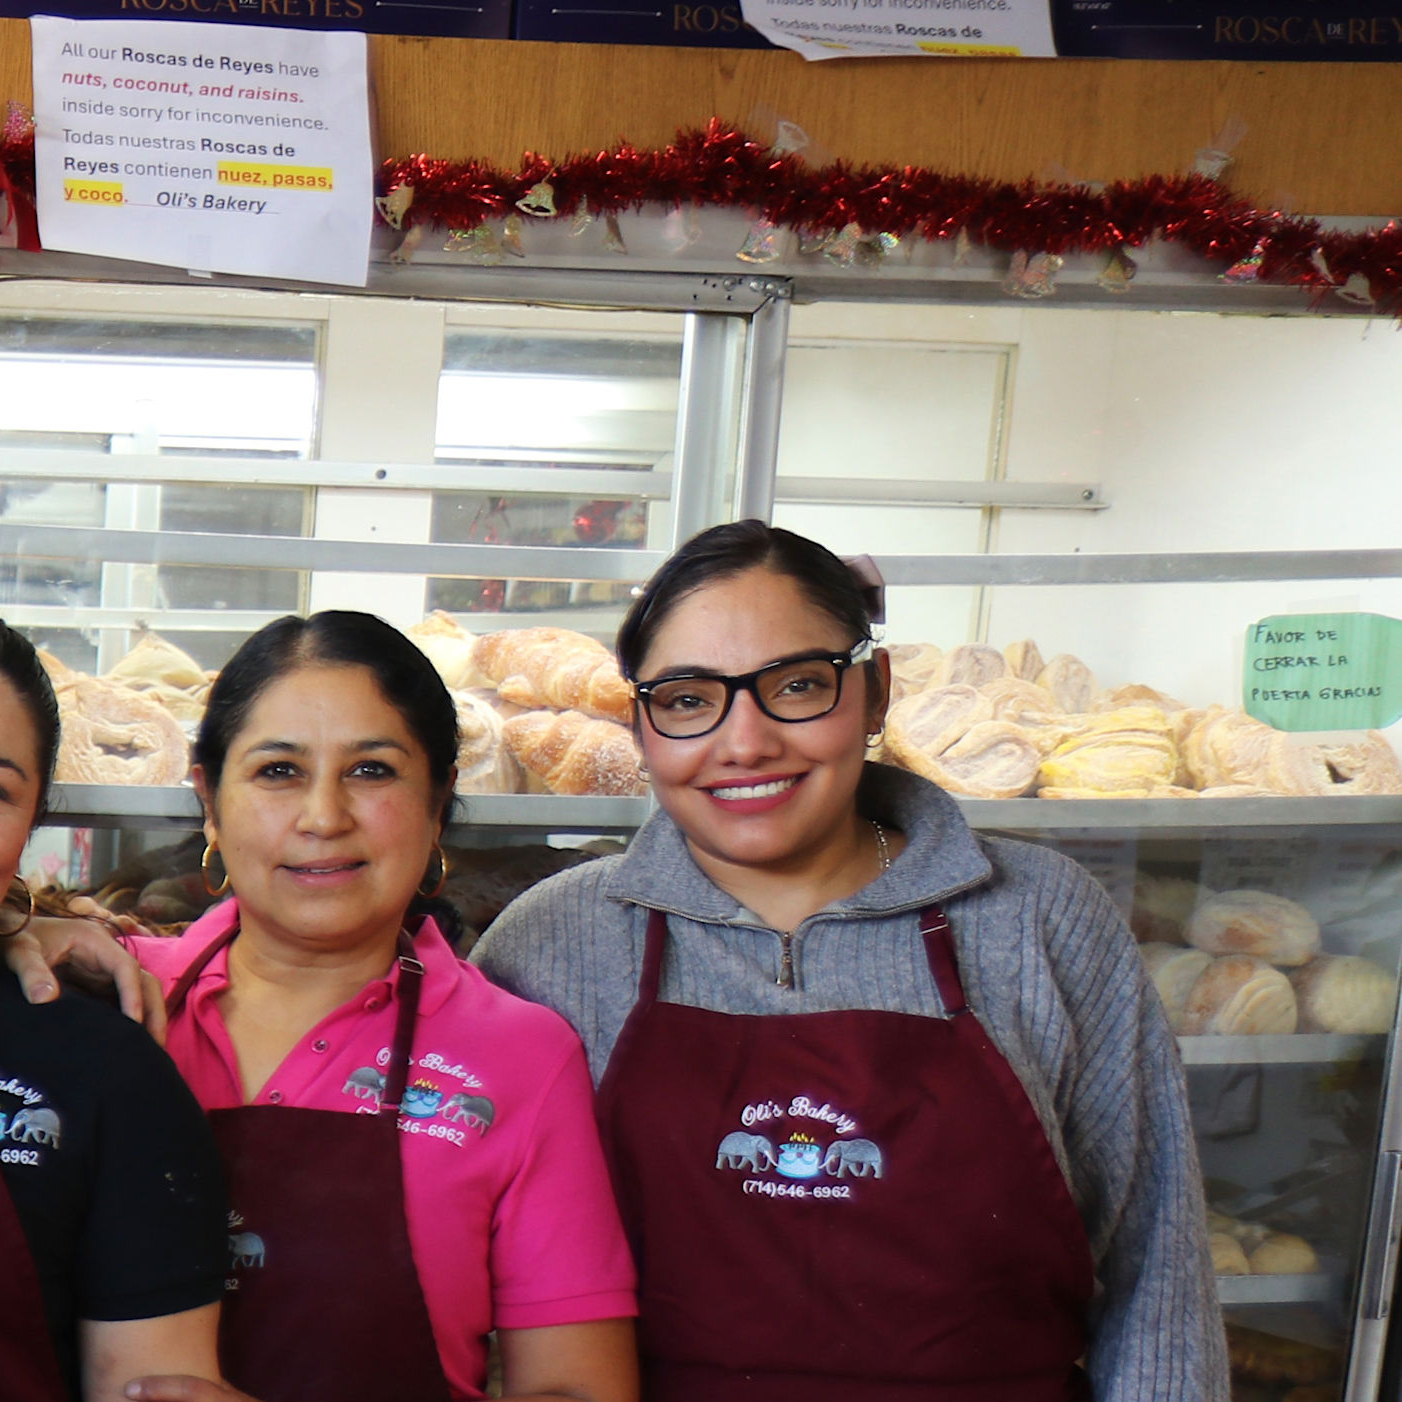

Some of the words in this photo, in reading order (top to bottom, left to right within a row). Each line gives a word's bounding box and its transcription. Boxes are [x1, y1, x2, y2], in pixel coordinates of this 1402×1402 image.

[673, 4, 755, 33] ROS
[896, 23, 956, 37] Roscas
[961, 24, 983, 38] de
[1214, 15, 1327, 44] ROSCA
[1327, 23, 1345, 37] DE
[61, 42, 83, 57] All
[88, 47, 117, 60] our
[122, 47, 187, 67] Roscas
[192, 54, 214, 69] de
[220, 56, 274, 75] Reyes
[278, 61, 320, 77] have
[62, 72, 107, 90] nuts,
[113, 76, 194, 97] coconut,
[199, 84, 234, 98] and
[238, 86, 304, 103] raisins.
[62, 97, 114, 116] inside
[119, 105, 163, 122] sorry
[168, 106, 192, 121] for
[195, 108, 329, 131] inconvenience.
[62, 128, 114, 146] Todas
[119, 136, 196, 151] nuestras
[201, 138, 268, 155] Roscas
[273, 143, 296, 157] de
[64, 157, 119, 175] Reyes
[124, 162, 213, 180] contienen
[218, 168, 268, 185] nuez,
[273, 172, 333, 190] pasas,
[64, 187, 74, 201] y
[78, 188, 128, 203] coco.
[202, 194, 267, 215] Bakery
[1254, 624, 1306, 644] FAVOR
[1316, 630, 1338, 641] DE
[1253, 655, 1320, 672] CERRAR
[1328, 655, 1348, 667] LA
[1251, 688, 1311, 701] PUERTA
[1319, 686, 1383, 700] GRACIAS
[418, 1052, 483, 1089] Bakery
[741, 1101, 783, 1127] Oli's
[788, 1096, 857, 1134] Bakery
[743, 1179, 851, 1199] (714)546-6962
